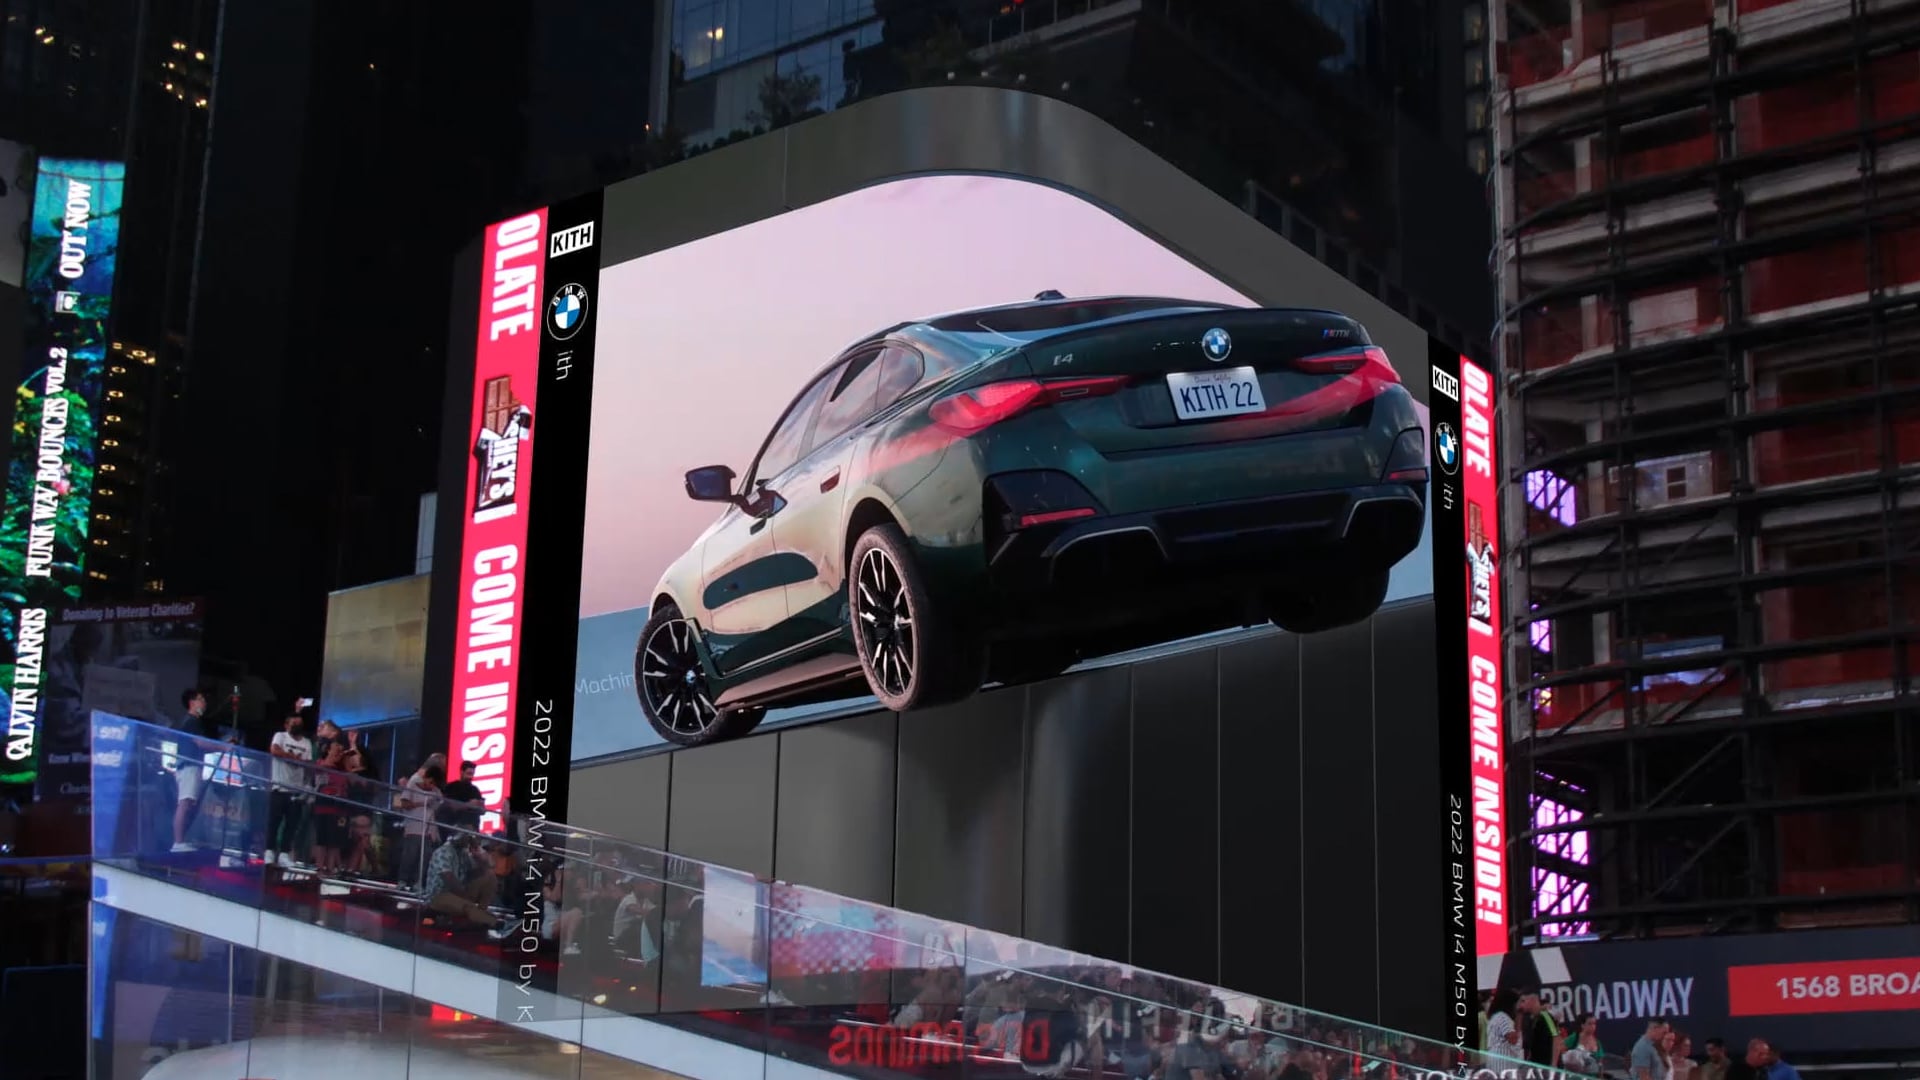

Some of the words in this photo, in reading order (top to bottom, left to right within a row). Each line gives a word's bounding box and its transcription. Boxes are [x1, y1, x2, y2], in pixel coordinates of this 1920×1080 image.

[65, 180, 92, 230] NOW
[59, 231, 88, 279] OUT
[552, 224, 592, 253] KITH
[490, 213, 541, 341] OLATE
[552, 284, 588, 307] BMW
[555, 350, 574, 381] ith
[1433, 369, 1458, 397] KITH
[1180, 384, 1229, 413] KITH
[1230, 381, 1260, 408] 22
[1464, 361, 1491, 478] OLATE
[37, 397, 69, 482] BOUNCES
[26, 523, 55, 577] FUNK
[63, 608, 103, 622] Donating
[116, 605, 150, 619] Veteran
[467, 544, 519, 673] COME
[15, 608, 47, 685] HARRIS
[6, 688, 34, 760] CALVIN
[532, 699, 552, 767] 2022
[1471, 654, 1498, 769] COME
[527, 776, 548, 848] BMW
[1450, 793, 1462, 855] 2022
[525, 857, 543, 881] i4
[1474, 775, 1502, 925] INSIDE!
[1452, 862, 1465, 927] BMW
[521, 891, 541, 953] M50
[1453, 932, 1465, 954] i4
[515, 964, 537, 995] by
[1454, 962, 1467, 1017] M50
[1776, 974, 1841, 1000] 1568
[517, 1005, 534, 1021] K
[1453, 1025, 1468, 1054] by
